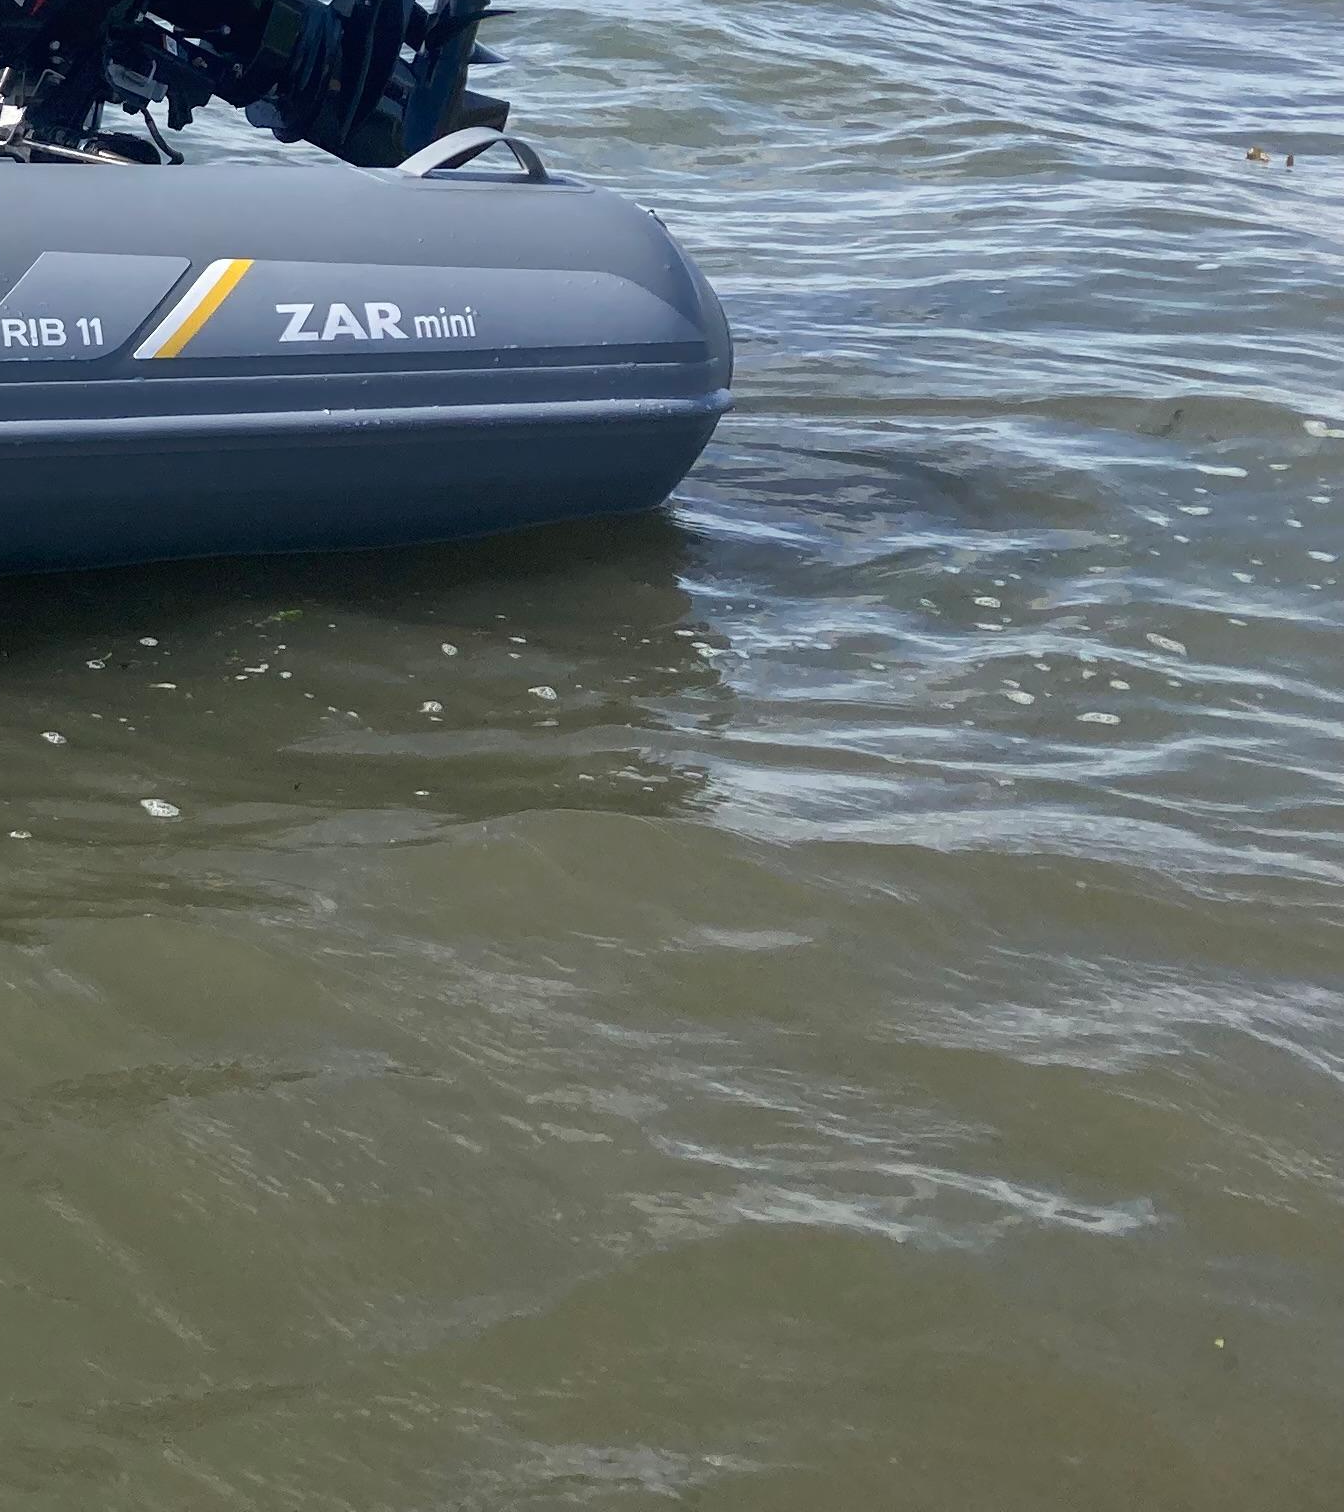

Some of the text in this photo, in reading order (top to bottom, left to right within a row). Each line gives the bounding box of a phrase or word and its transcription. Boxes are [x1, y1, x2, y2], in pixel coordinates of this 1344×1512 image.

[1, 317, 104, 347] RIB 11
[275, 302, 476, 342] ZAR mini
